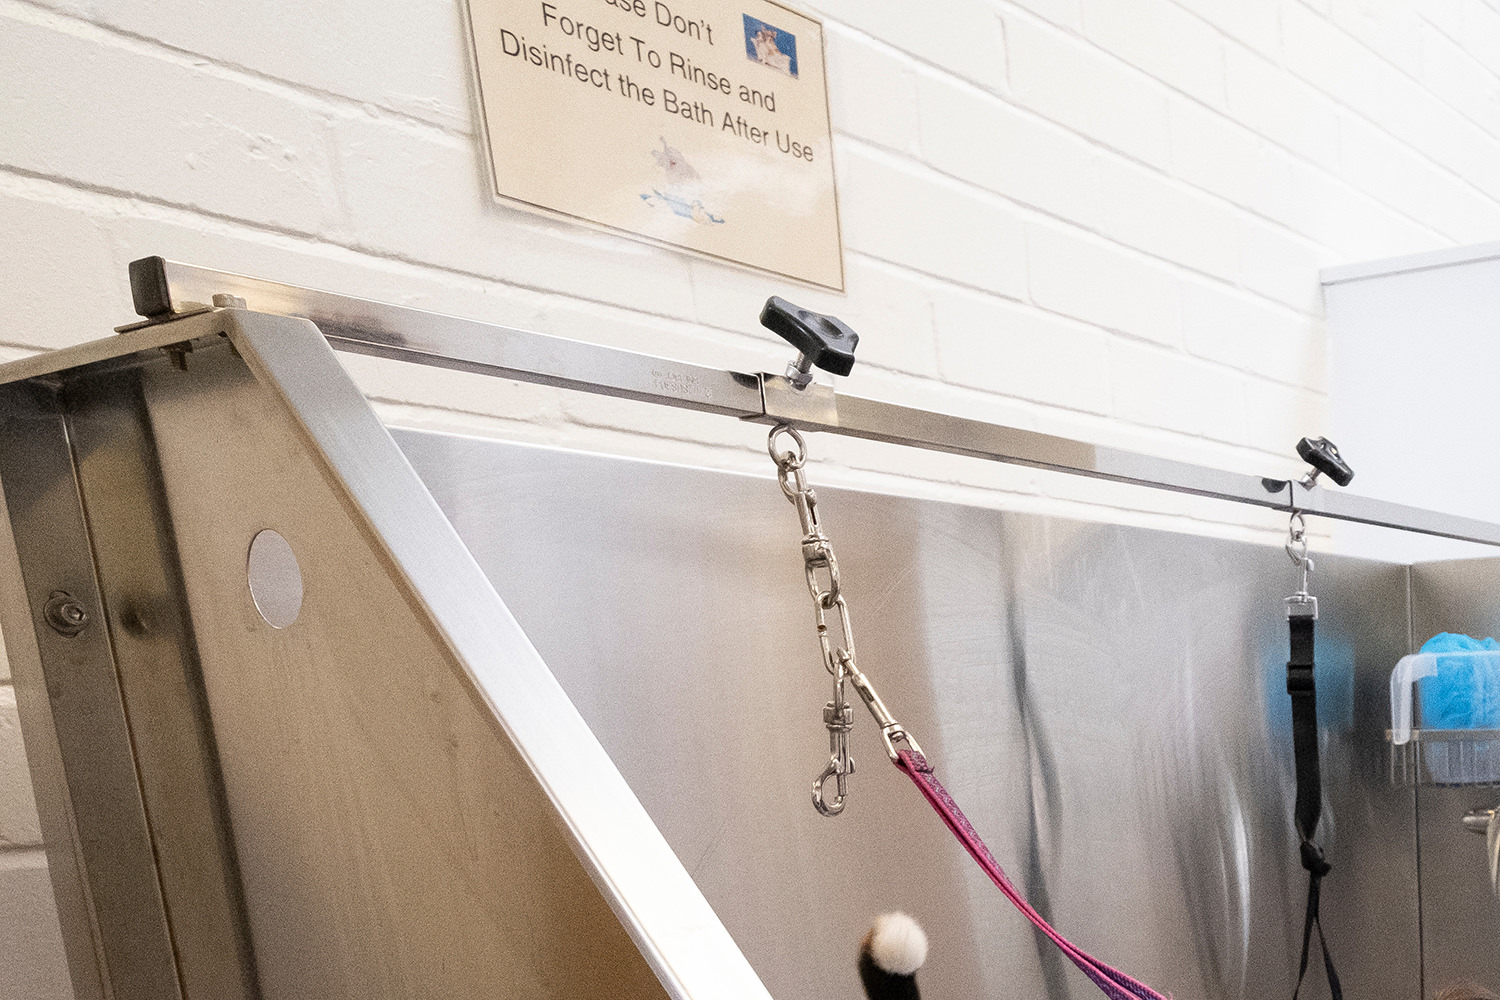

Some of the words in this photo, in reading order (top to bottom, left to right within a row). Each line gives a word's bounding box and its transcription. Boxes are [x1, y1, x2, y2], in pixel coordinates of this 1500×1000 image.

[542, 2, 624, 56] Forget
[629, 36, 661, 69] To
[669, 51, 732, 95] Rinse
[739, 82, 776, 113] and
[654, 0, 714, 46] Don't
[500, 28, 612, 92] Disinfect
[618, 74, 656, 107] the
[663, 88, 714, 127] Bath
[722, 111, 769, 146] After
[776, 130, 814, 162] Use
